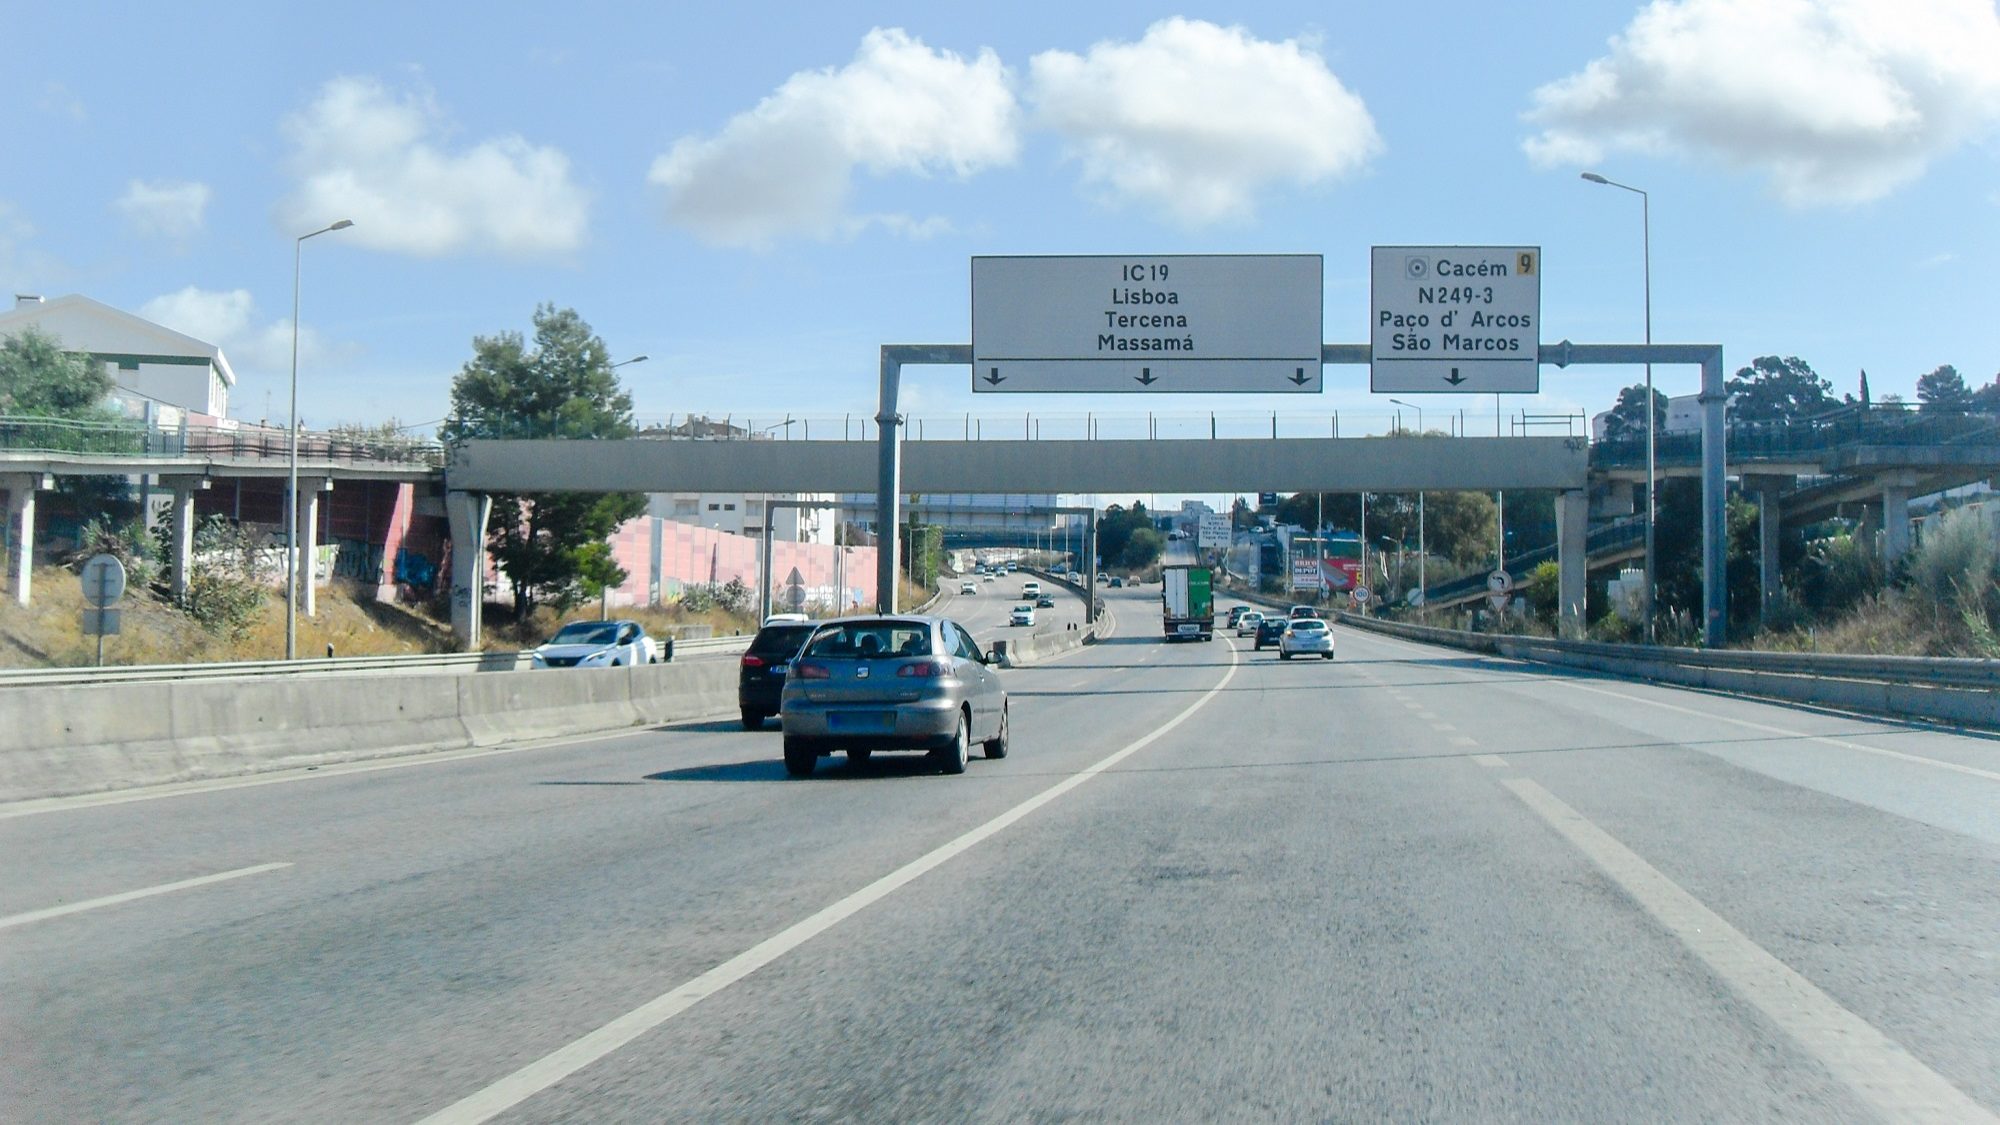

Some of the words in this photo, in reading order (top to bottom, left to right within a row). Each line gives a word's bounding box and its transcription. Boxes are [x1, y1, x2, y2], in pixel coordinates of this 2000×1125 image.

[1436, 259, 1508, 277] Cacém
[1520, 254, 1531, 273] 9
[1112, 287, 1179, 305] Lisboa
[1104, 311, 1188, 328] Tercena
[1380, 310, 1430, 332] Paço
[1470, 310, 1531, 328] Arcos
[1098, 334, 1194, 351] Massamá
[1391, 333, 1431, 351] São
[1443, 333, 1520, 351] Marcos
